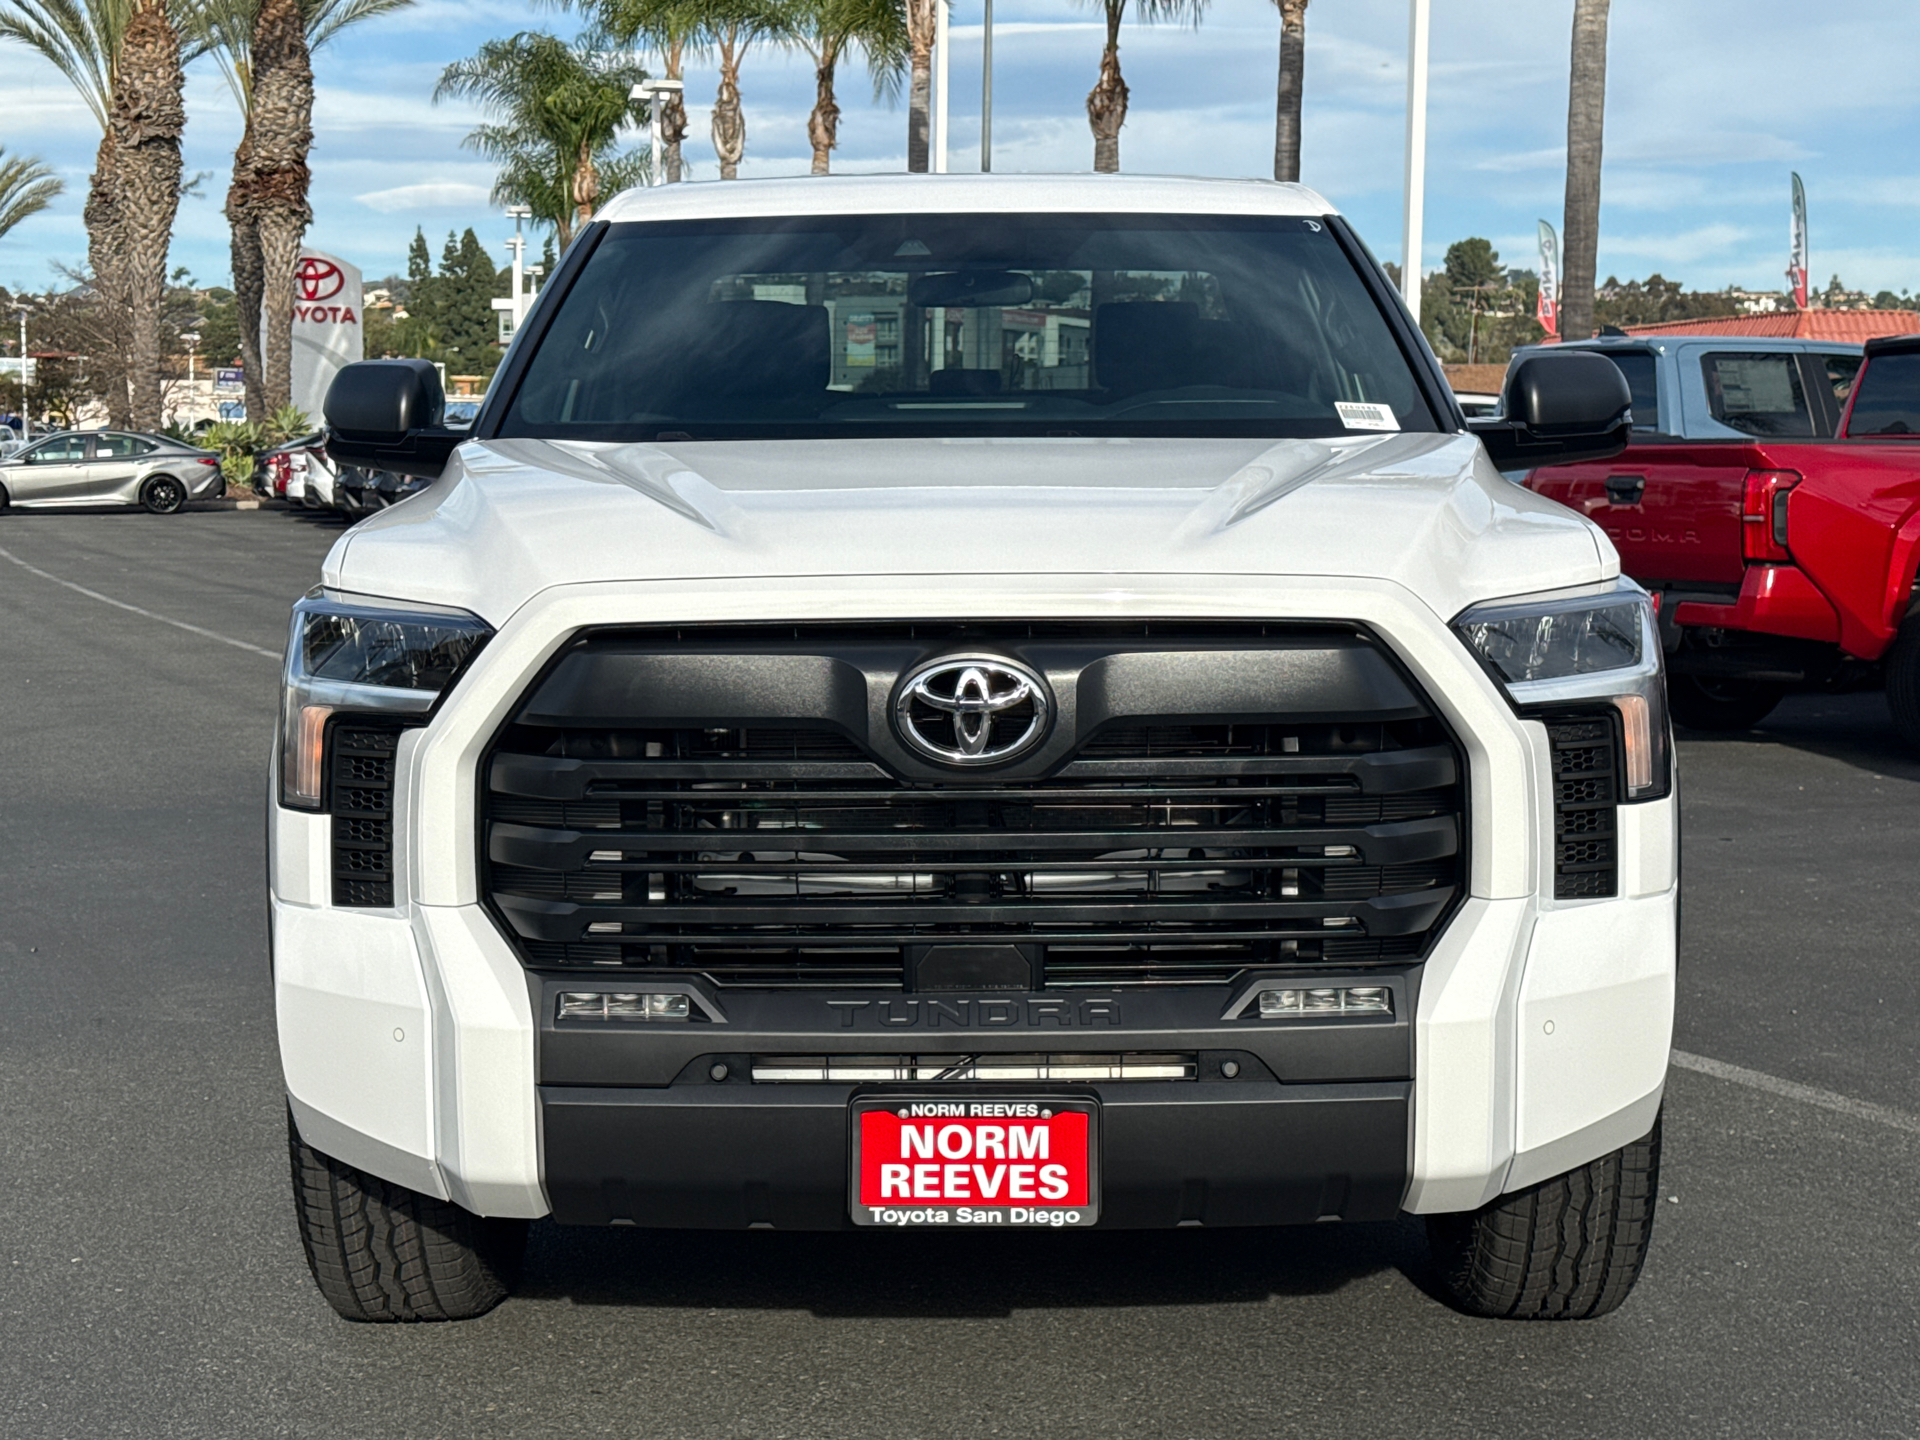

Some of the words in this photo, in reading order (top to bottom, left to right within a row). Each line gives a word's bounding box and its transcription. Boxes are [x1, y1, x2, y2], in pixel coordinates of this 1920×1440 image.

[290, 305, 358, 325] YOTA
[1607, 528, 1701, 544] COMA
[826, 999, 1121, 1028] TUNDRA
[911, 1104, 965, 1117] NORM
[970, 1104, 1038, 1117] REEVES
[900, 1124, 1050, 1160] NORM
[880, 1163, 1069, 1200] REEVES
[869, 1207, 949, 1226] Toyota
[956, 1207, 1002, 1223] San
[1009, 1206, 1081, 1226] Diego
